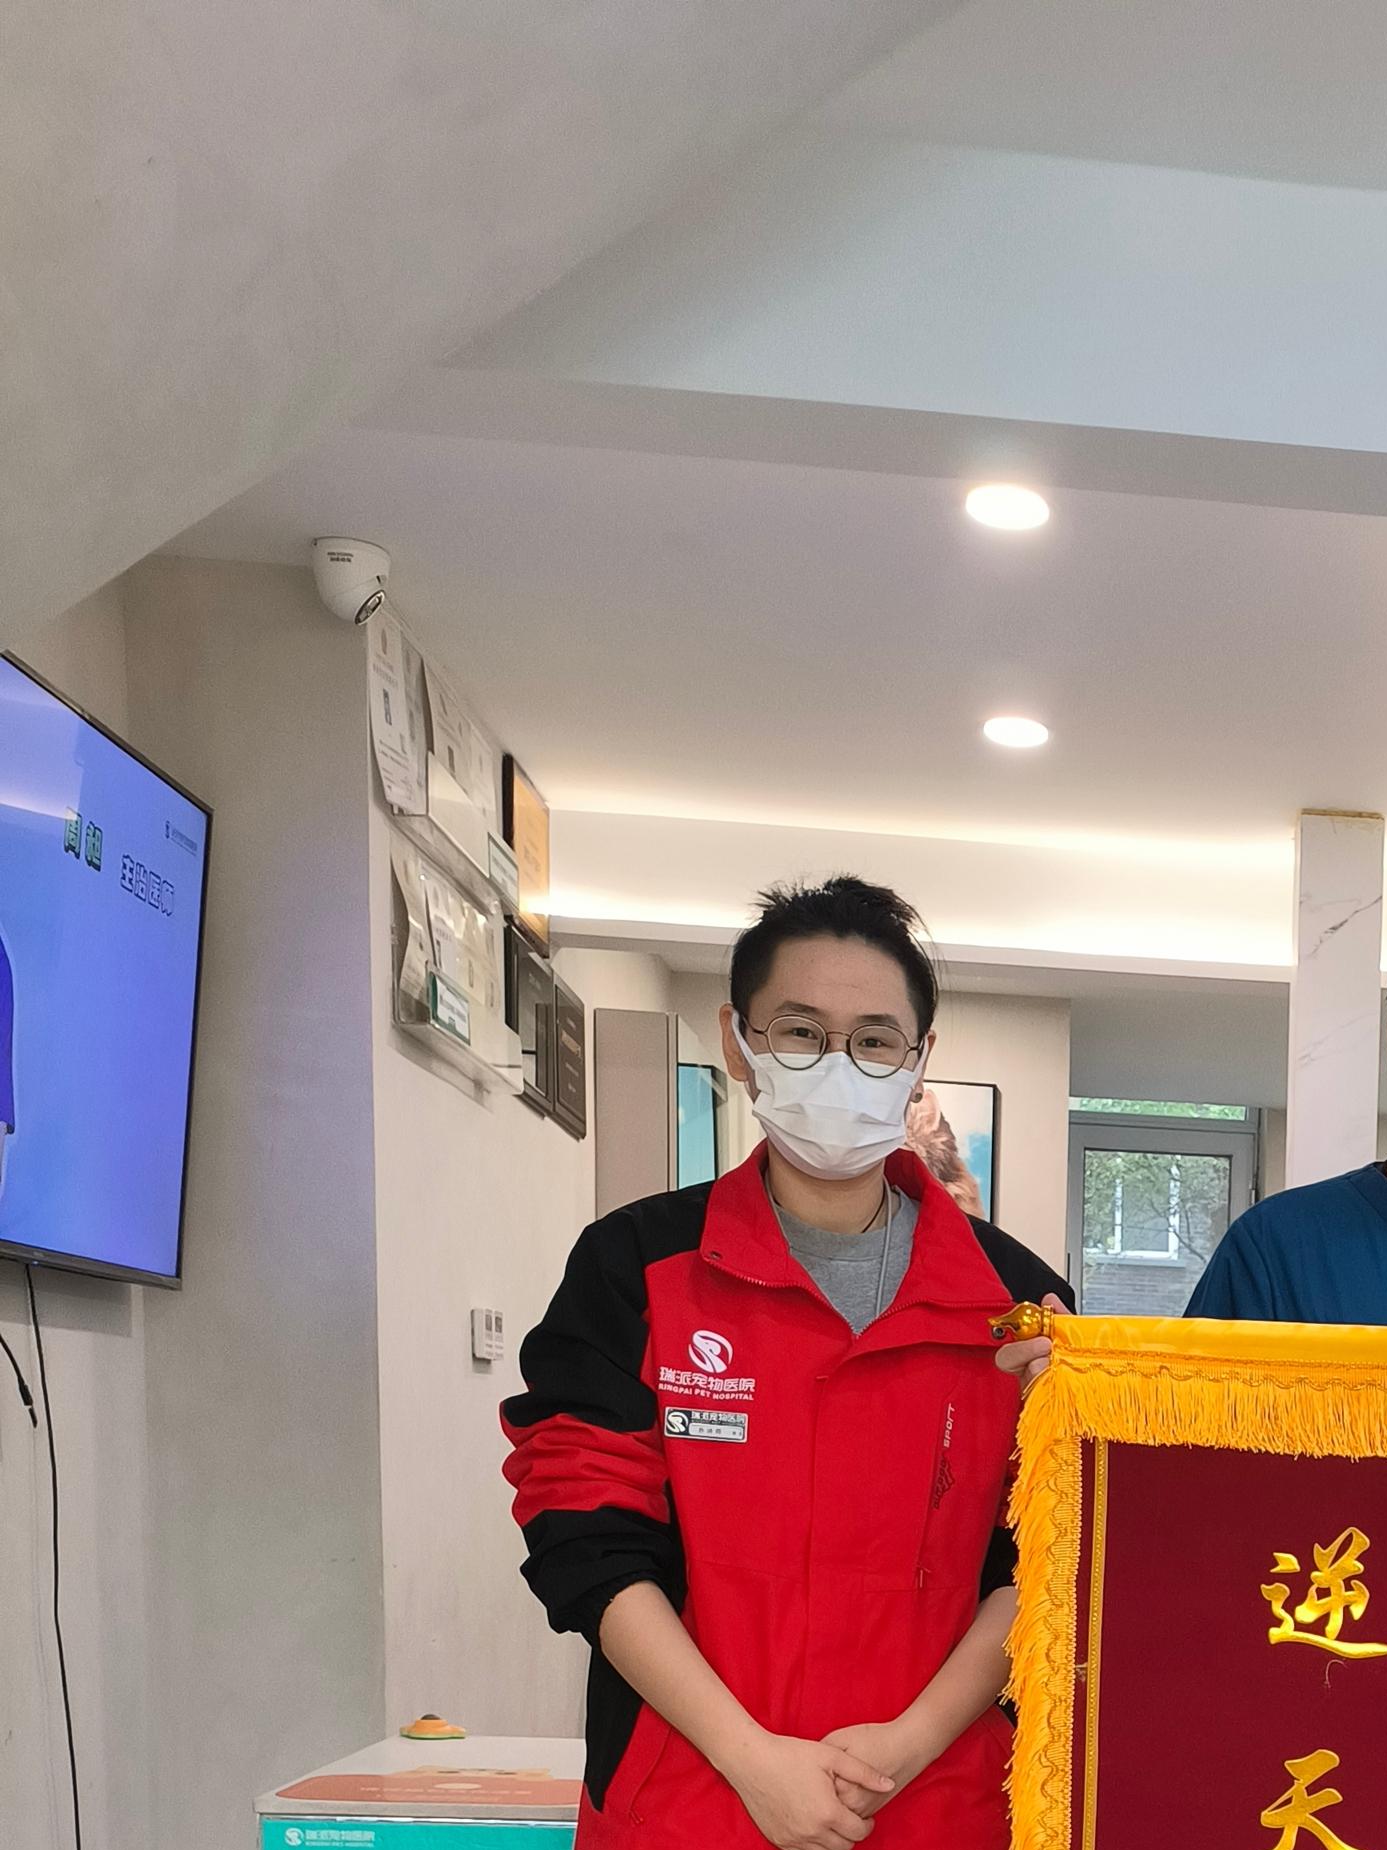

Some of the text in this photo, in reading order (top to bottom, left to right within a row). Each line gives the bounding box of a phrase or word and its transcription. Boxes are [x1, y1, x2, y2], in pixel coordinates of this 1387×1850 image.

[121, 854, 175, 917] 主治医师
[658, 1382, 755, 1401] RINGPAI PET HOSPITAL
[659, 1366, 756, 1392] 瑞派宠物医院
